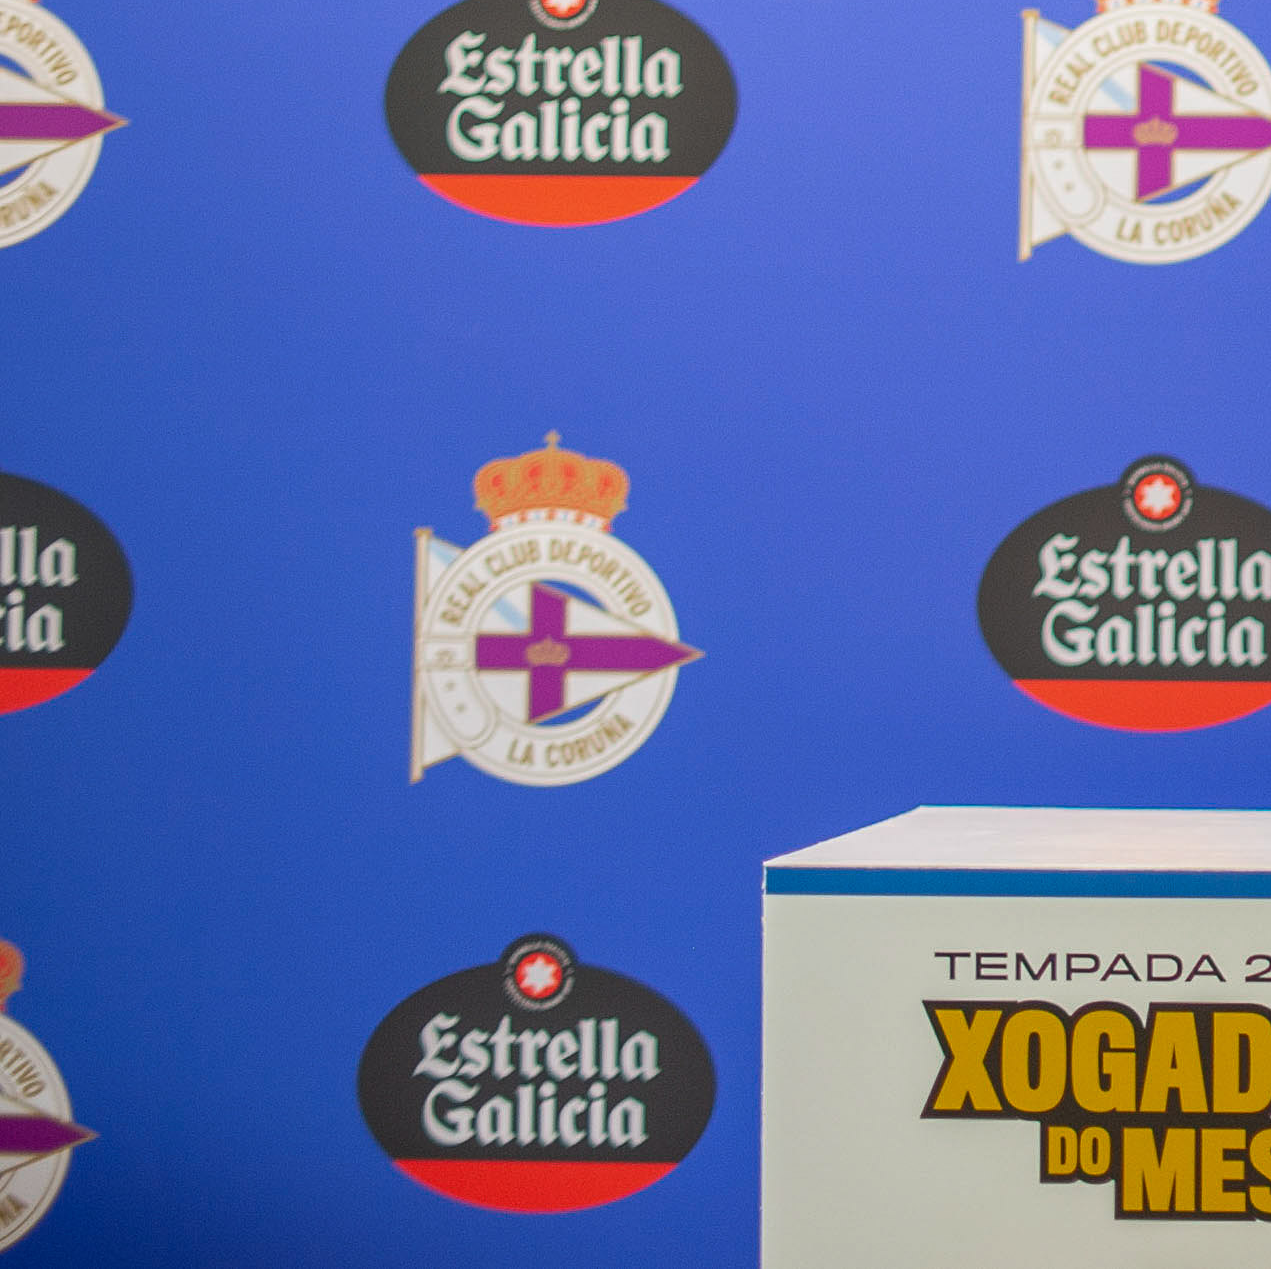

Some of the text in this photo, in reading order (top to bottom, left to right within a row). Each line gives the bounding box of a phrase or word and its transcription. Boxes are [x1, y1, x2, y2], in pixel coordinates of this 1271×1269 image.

[0, 12, 78, 86] PORTIVO
[439, 33, 681, 95] Estrella
[1048, 19, 1259, 107] REAL CLUB DEPORTIVO
[448, 97, 669, 161] Galicia
[1115, 216, 1142, 246] LA
[441, 538, 653, 627] REAL CLUB DEPORTIVO
[1042, 601, 1266, 665] Galicia
[507, 738, 534, 768] LA
[934, 952, 1227, 984] TEMPADA
[414, 1014, 659, 1079] Estrella
[423, 1080, 647, 1146] Galicia
[1044, 1123, 1114, 1181] DO
